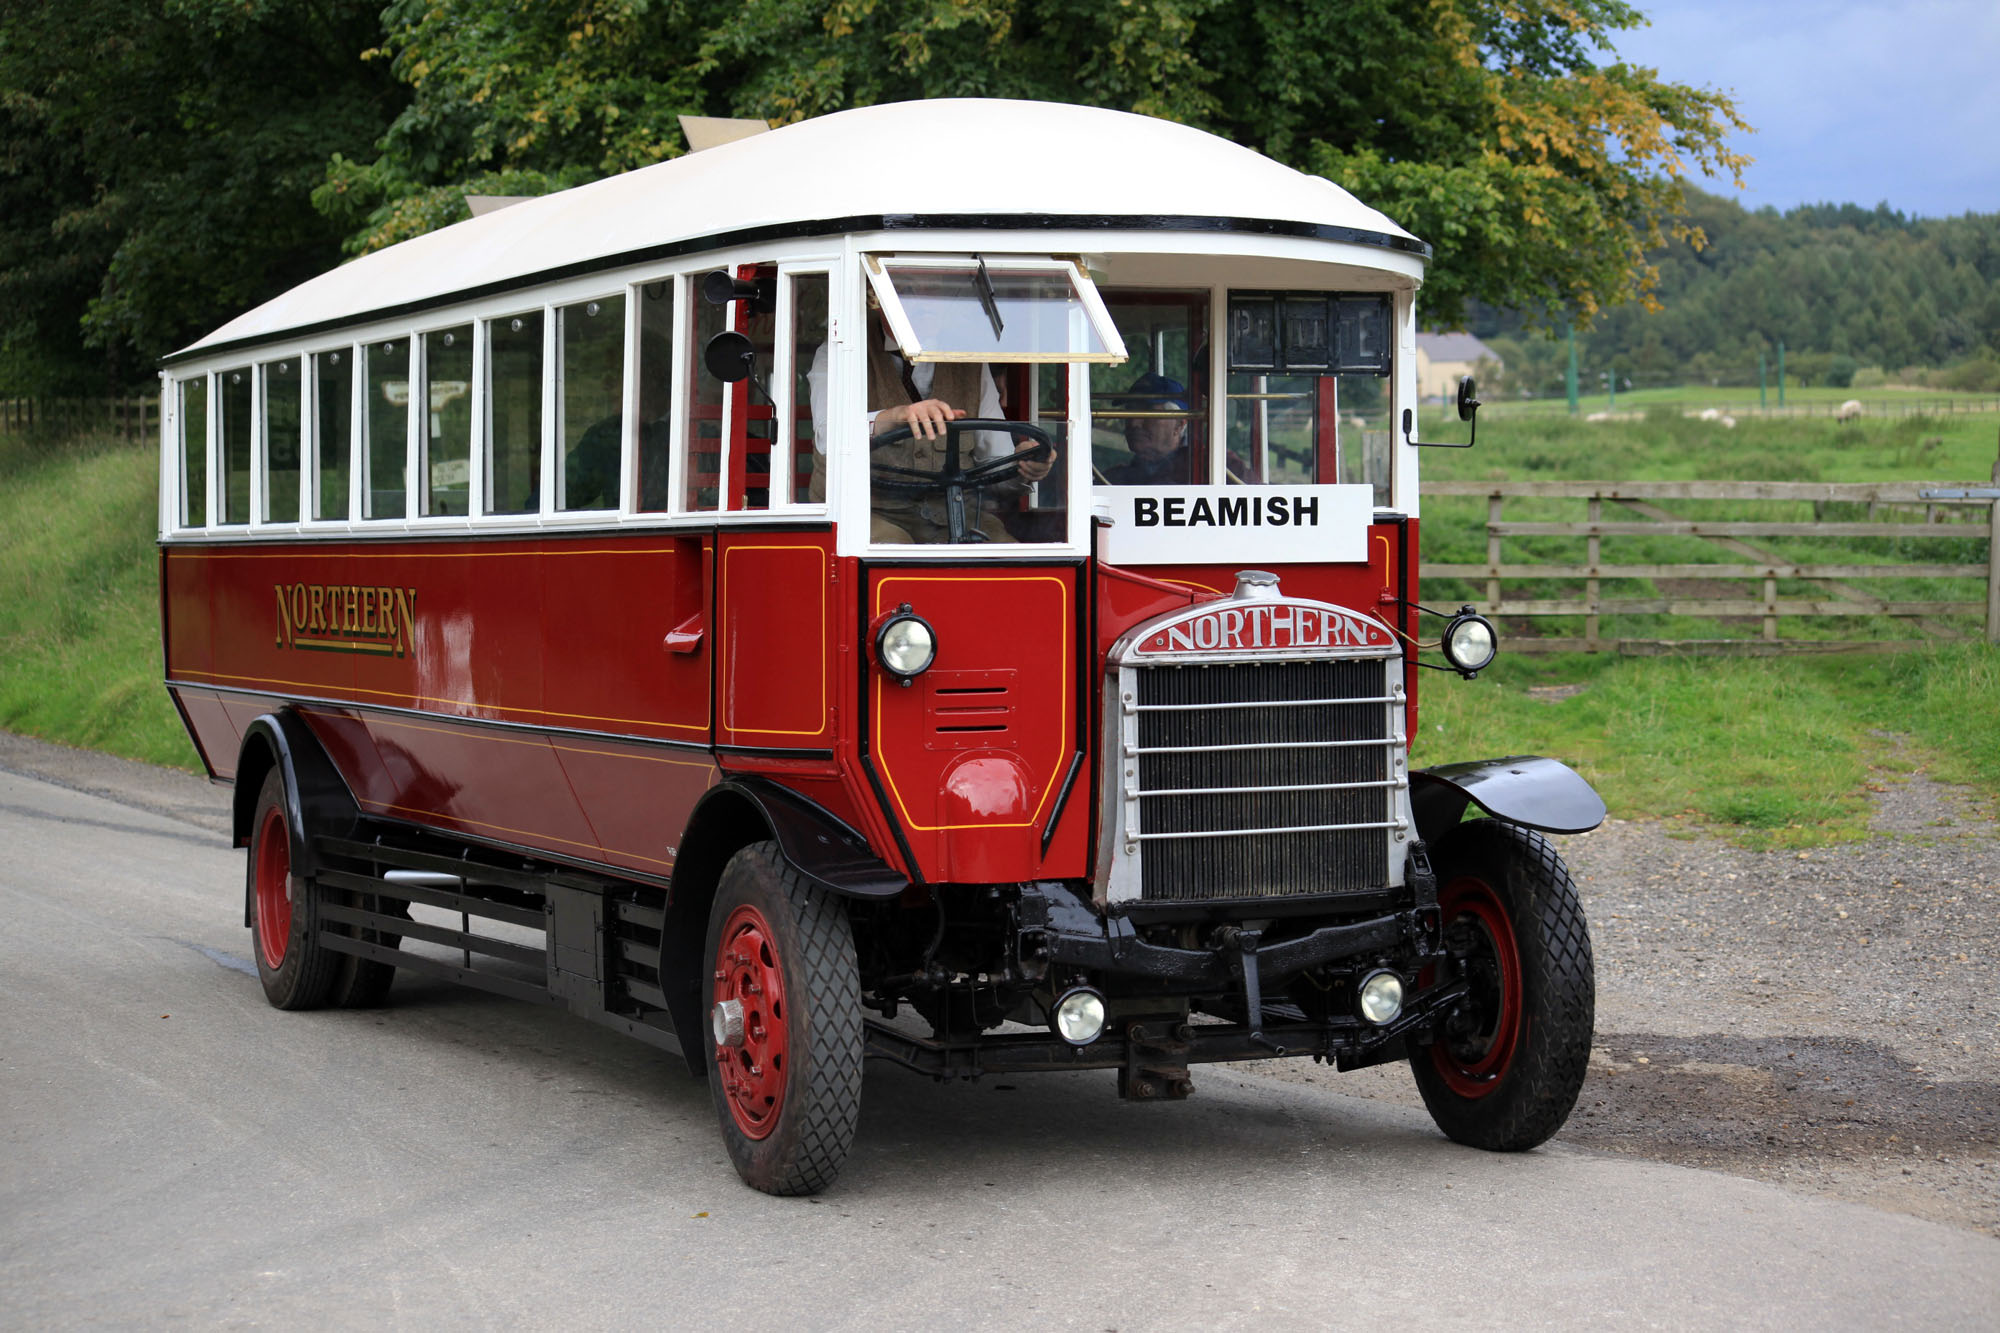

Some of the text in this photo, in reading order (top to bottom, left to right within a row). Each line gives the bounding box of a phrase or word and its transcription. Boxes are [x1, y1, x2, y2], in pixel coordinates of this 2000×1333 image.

[1134, 496, 1319, 527] BEAMISH
[274, 582, 417, 656] NORTHERN
[1167, 606, 1369, 651] NORTHERN
